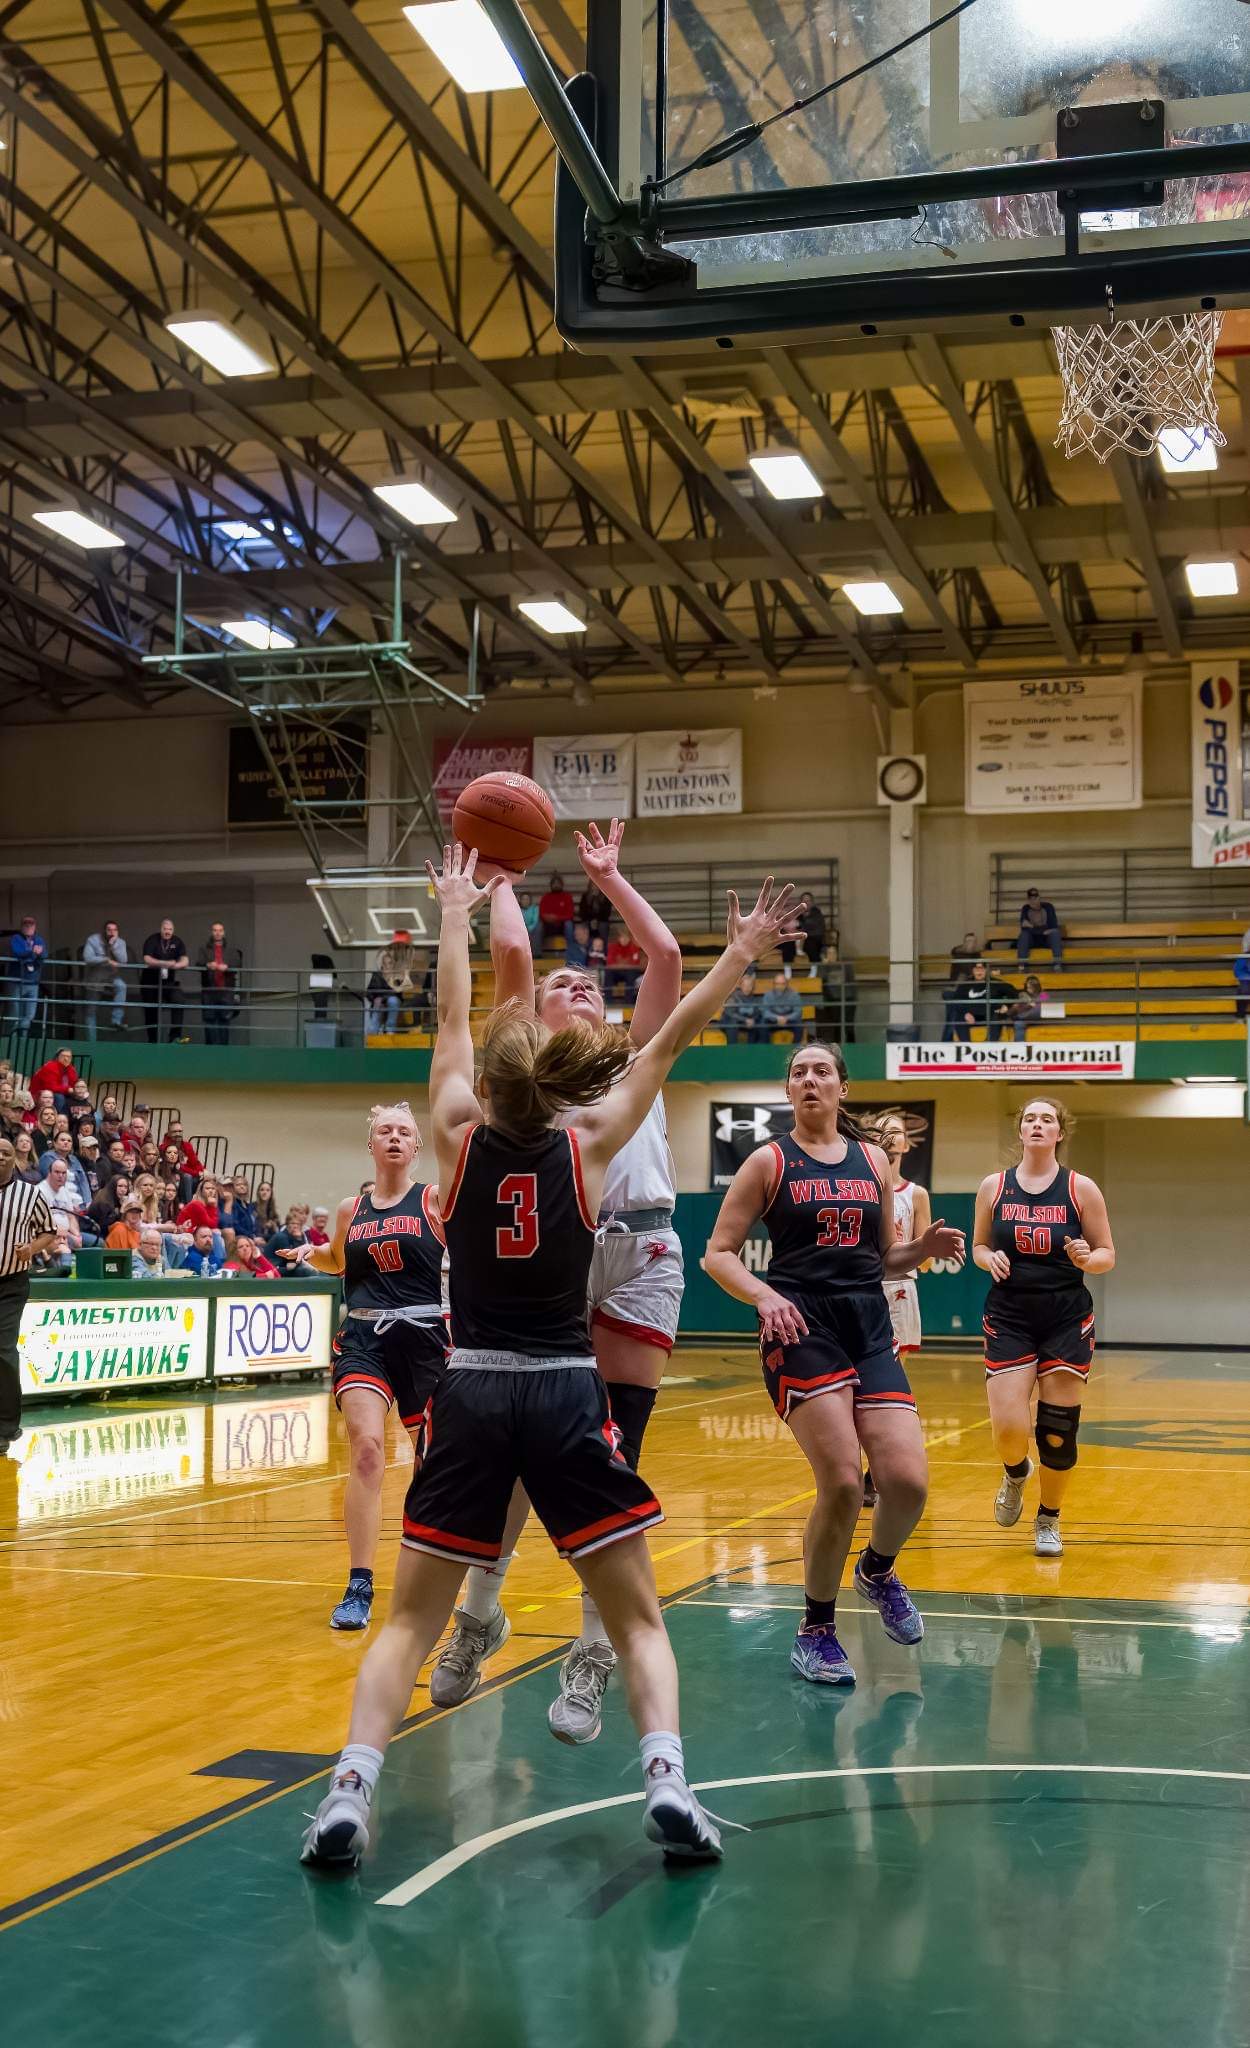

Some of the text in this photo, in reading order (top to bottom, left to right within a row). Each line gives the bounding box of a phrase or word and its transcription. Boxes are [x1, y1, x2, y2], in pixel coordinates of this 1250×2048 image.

[1204, 718, 1229, 817] PEPSI
[645, 774, 730, 791] JAMESTOWN
[642, 794, 714, 810] MATTRESS
[897, 1045, 1121, 1063] The Post-Journal
[789, 1179, 880, 1204] WILSON
[496, 1173, 540, 1259] 3
[1002, 1203, 1067, 1223] WILSON
[348, 1215, 422, 1243] WILSON
[816, 1208, 863, 1247] 33
[1014, 1226, 1052, 1255] 50
[367, 1240, 404, 1272] 10
[36, 1306, 179, 1327] JAMESTOWN
[228, 1302, 312, 1357] ROBO
[44, 1344, 190, 1383] JAYHAWKS
